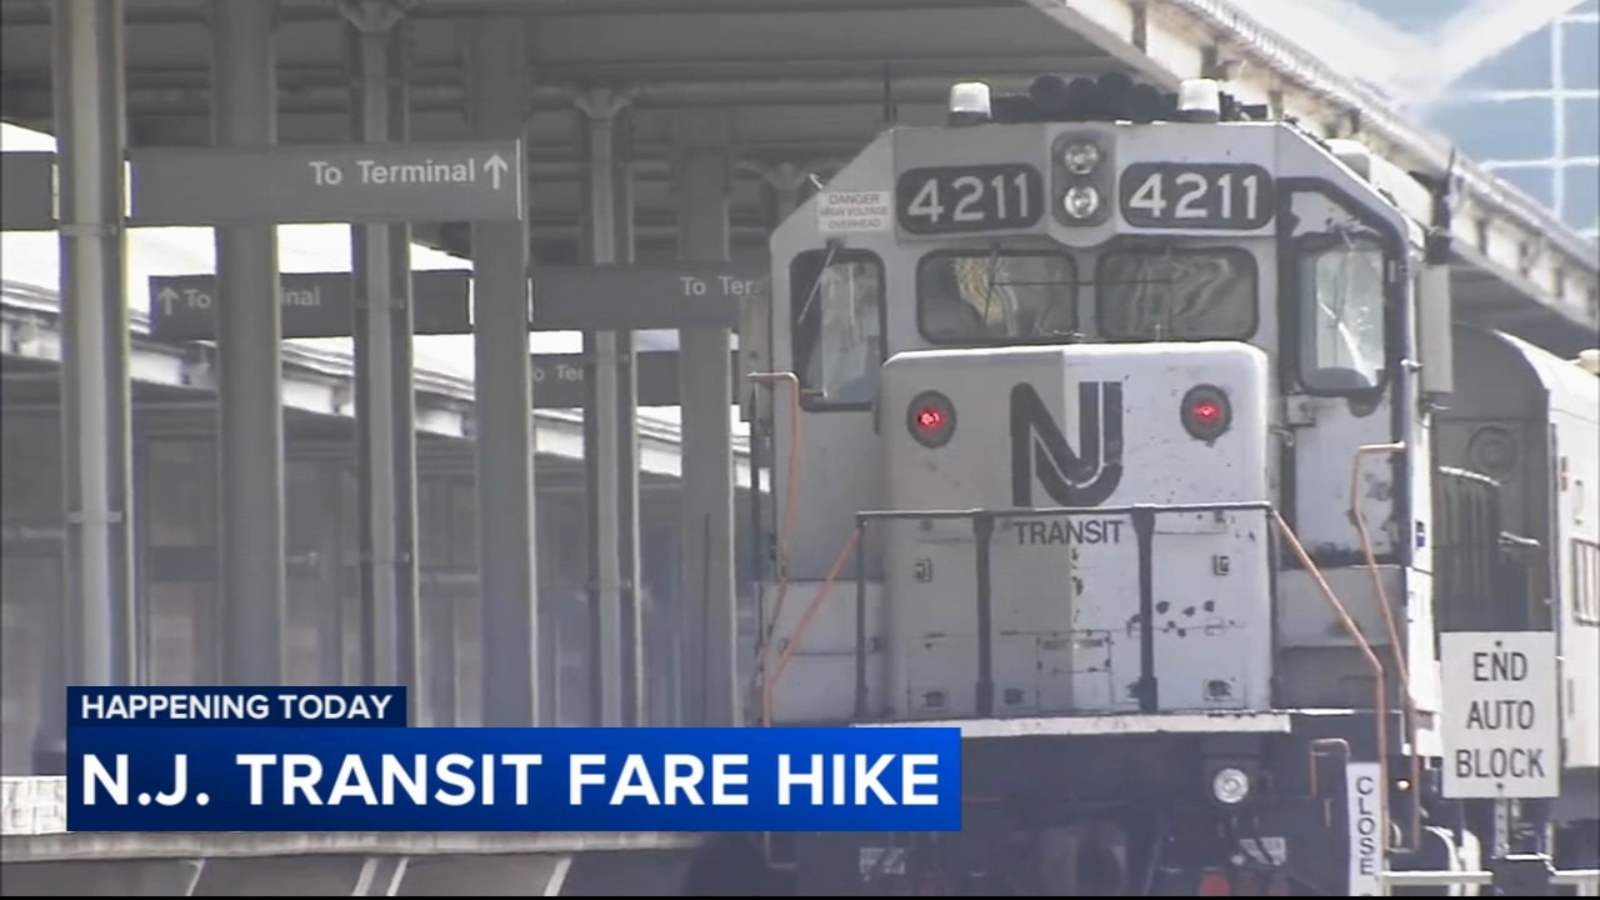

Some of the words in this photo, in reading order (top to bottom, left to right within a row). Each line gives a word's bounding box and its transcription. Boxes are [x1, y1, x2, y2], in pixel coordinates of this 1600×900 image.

[309, 161, 342, 185] To
[356, 158, 475, 183] Terminal
[829, 193, 880, 205] DANGER
[907, 173, 1030, 222] 4211
[1128, 173, 1258, 220] 4211
[828, 218, 881, 229] OVERHEAD
[183, 288, 212, 309] To
[681, 276, 707, 296] To
[1013, 519, 1124, 545] TRANSIT
[1473, 652, 1528, 683] END
[1466, 700, 1536, 730] AUTO
[1456, 748, 1546, 779] BLOCK
[1356, 776, 1376, 896] CLOSE
